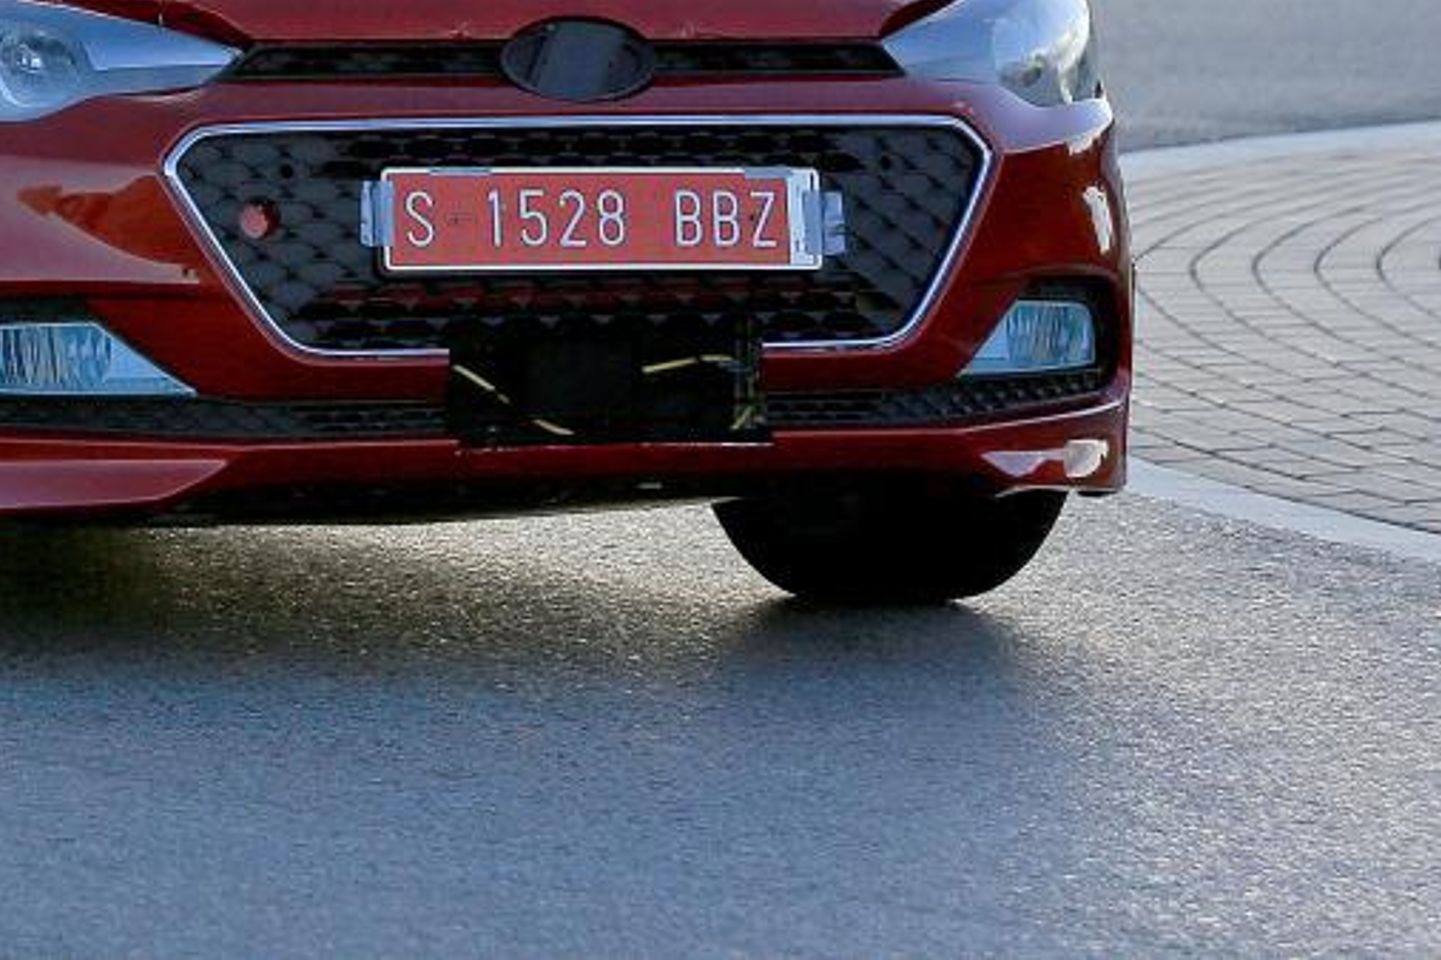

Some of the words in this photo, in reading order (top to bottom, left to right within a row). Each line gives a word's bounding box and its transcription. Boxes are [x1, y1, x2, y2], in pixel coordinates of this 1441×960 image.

[404, 190, 435, 248] S
[487, 189, 626, 248] 1528
[674, 190, 778, 248] BBZ
